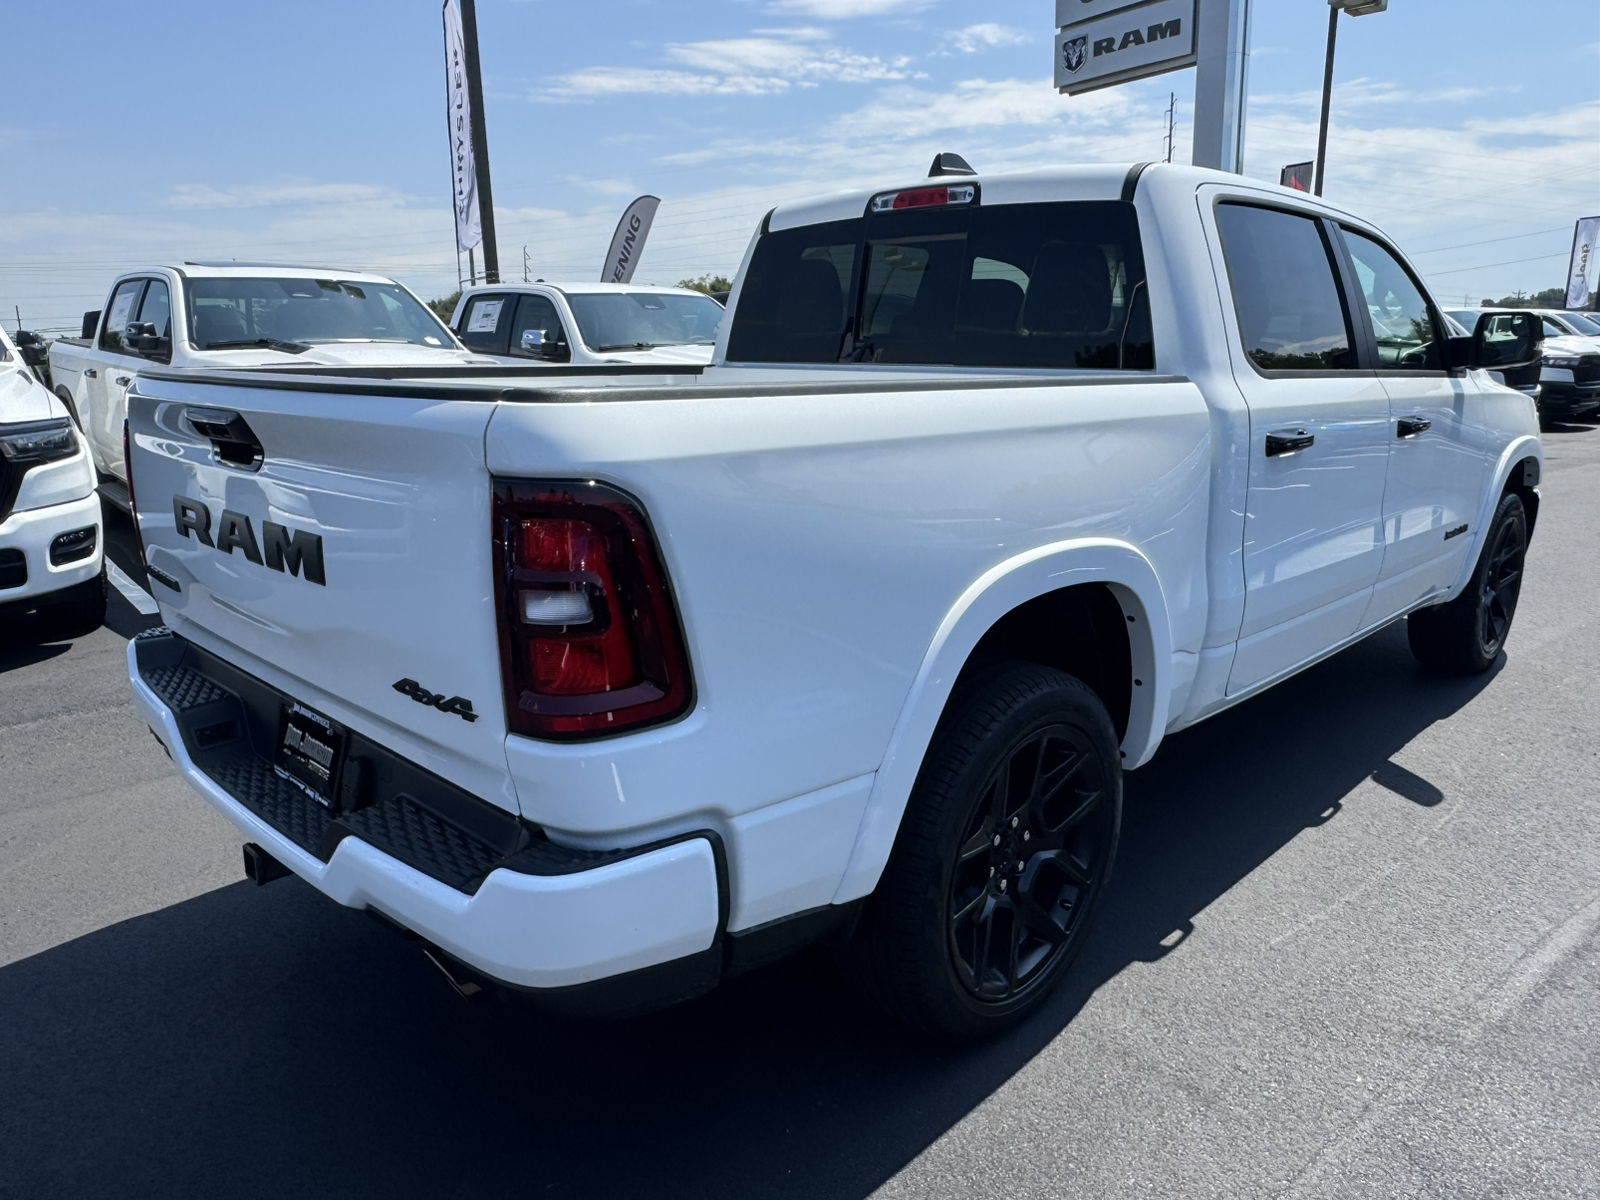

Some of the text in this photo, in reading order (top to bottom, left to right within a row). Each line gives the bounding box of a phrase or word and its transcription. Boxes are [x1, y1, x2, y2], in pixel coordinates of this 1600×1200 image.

[1093, 18, 1181, 57] RAM
[1575, 243, 1590, 284] Jeep
[173, 494, 326, 586] RAM
